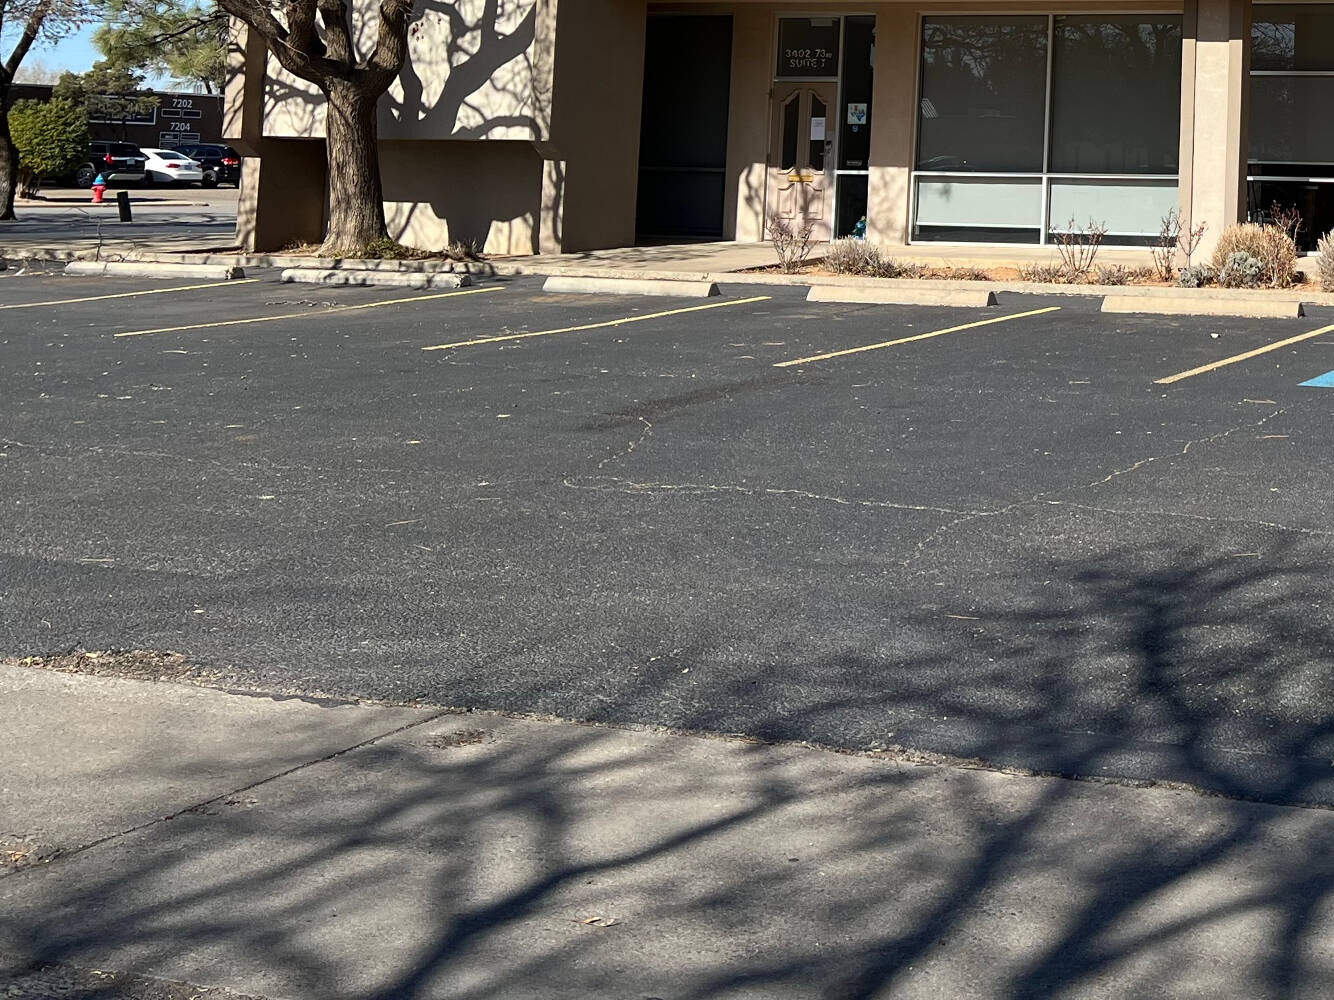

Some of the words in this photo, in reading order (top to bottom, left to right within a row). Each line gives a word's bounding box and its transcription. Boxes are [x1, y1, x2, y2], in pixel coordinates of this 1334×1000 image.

[785, 49, 811, 58] 3402
[172, 99, 193, 108] 7202
[170, 122, 191, 131] 7204
